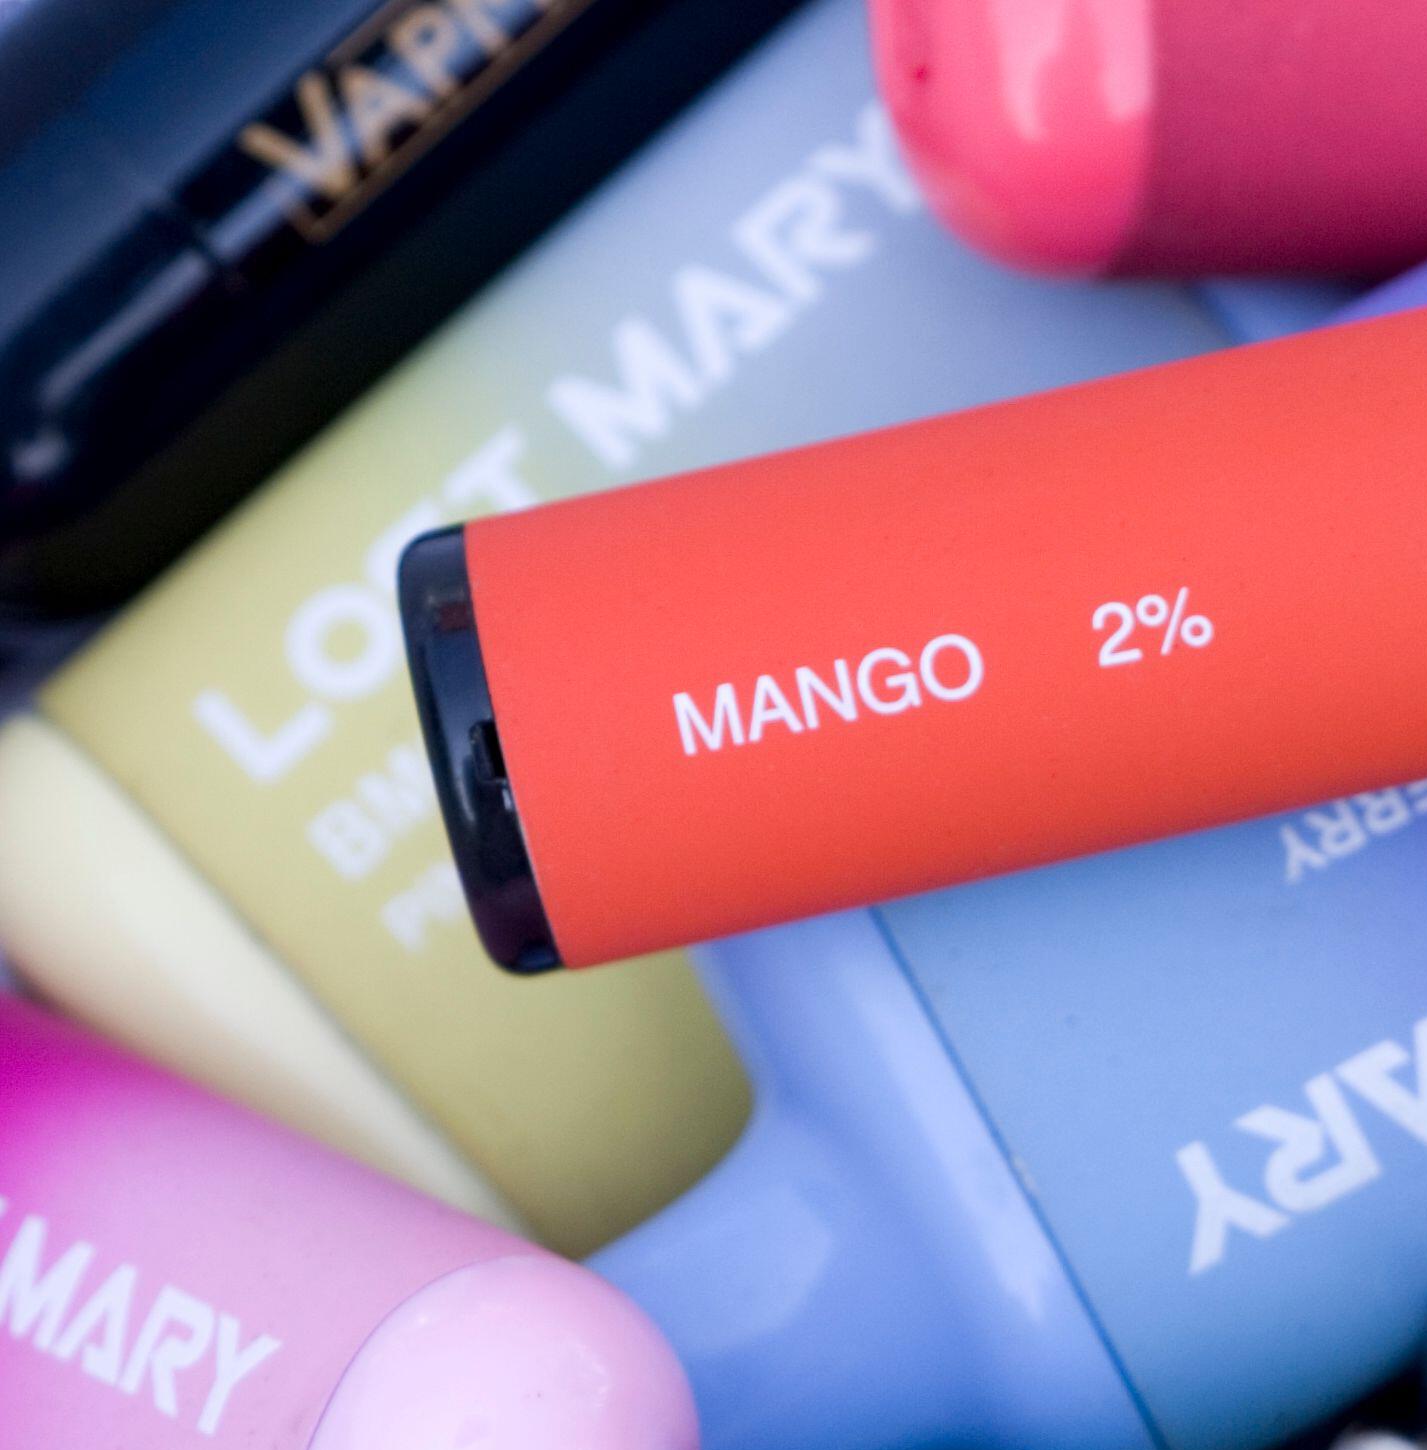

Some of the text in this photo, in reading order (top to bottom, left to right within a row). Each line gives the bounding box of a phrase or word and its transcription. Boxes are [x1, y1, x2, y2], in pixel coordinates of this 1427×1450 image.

[550, 105, 922, 475] MARY
[673, 586, 1213, 756] MANGO 2%
[0, 1213, 282, 1438] MARY
